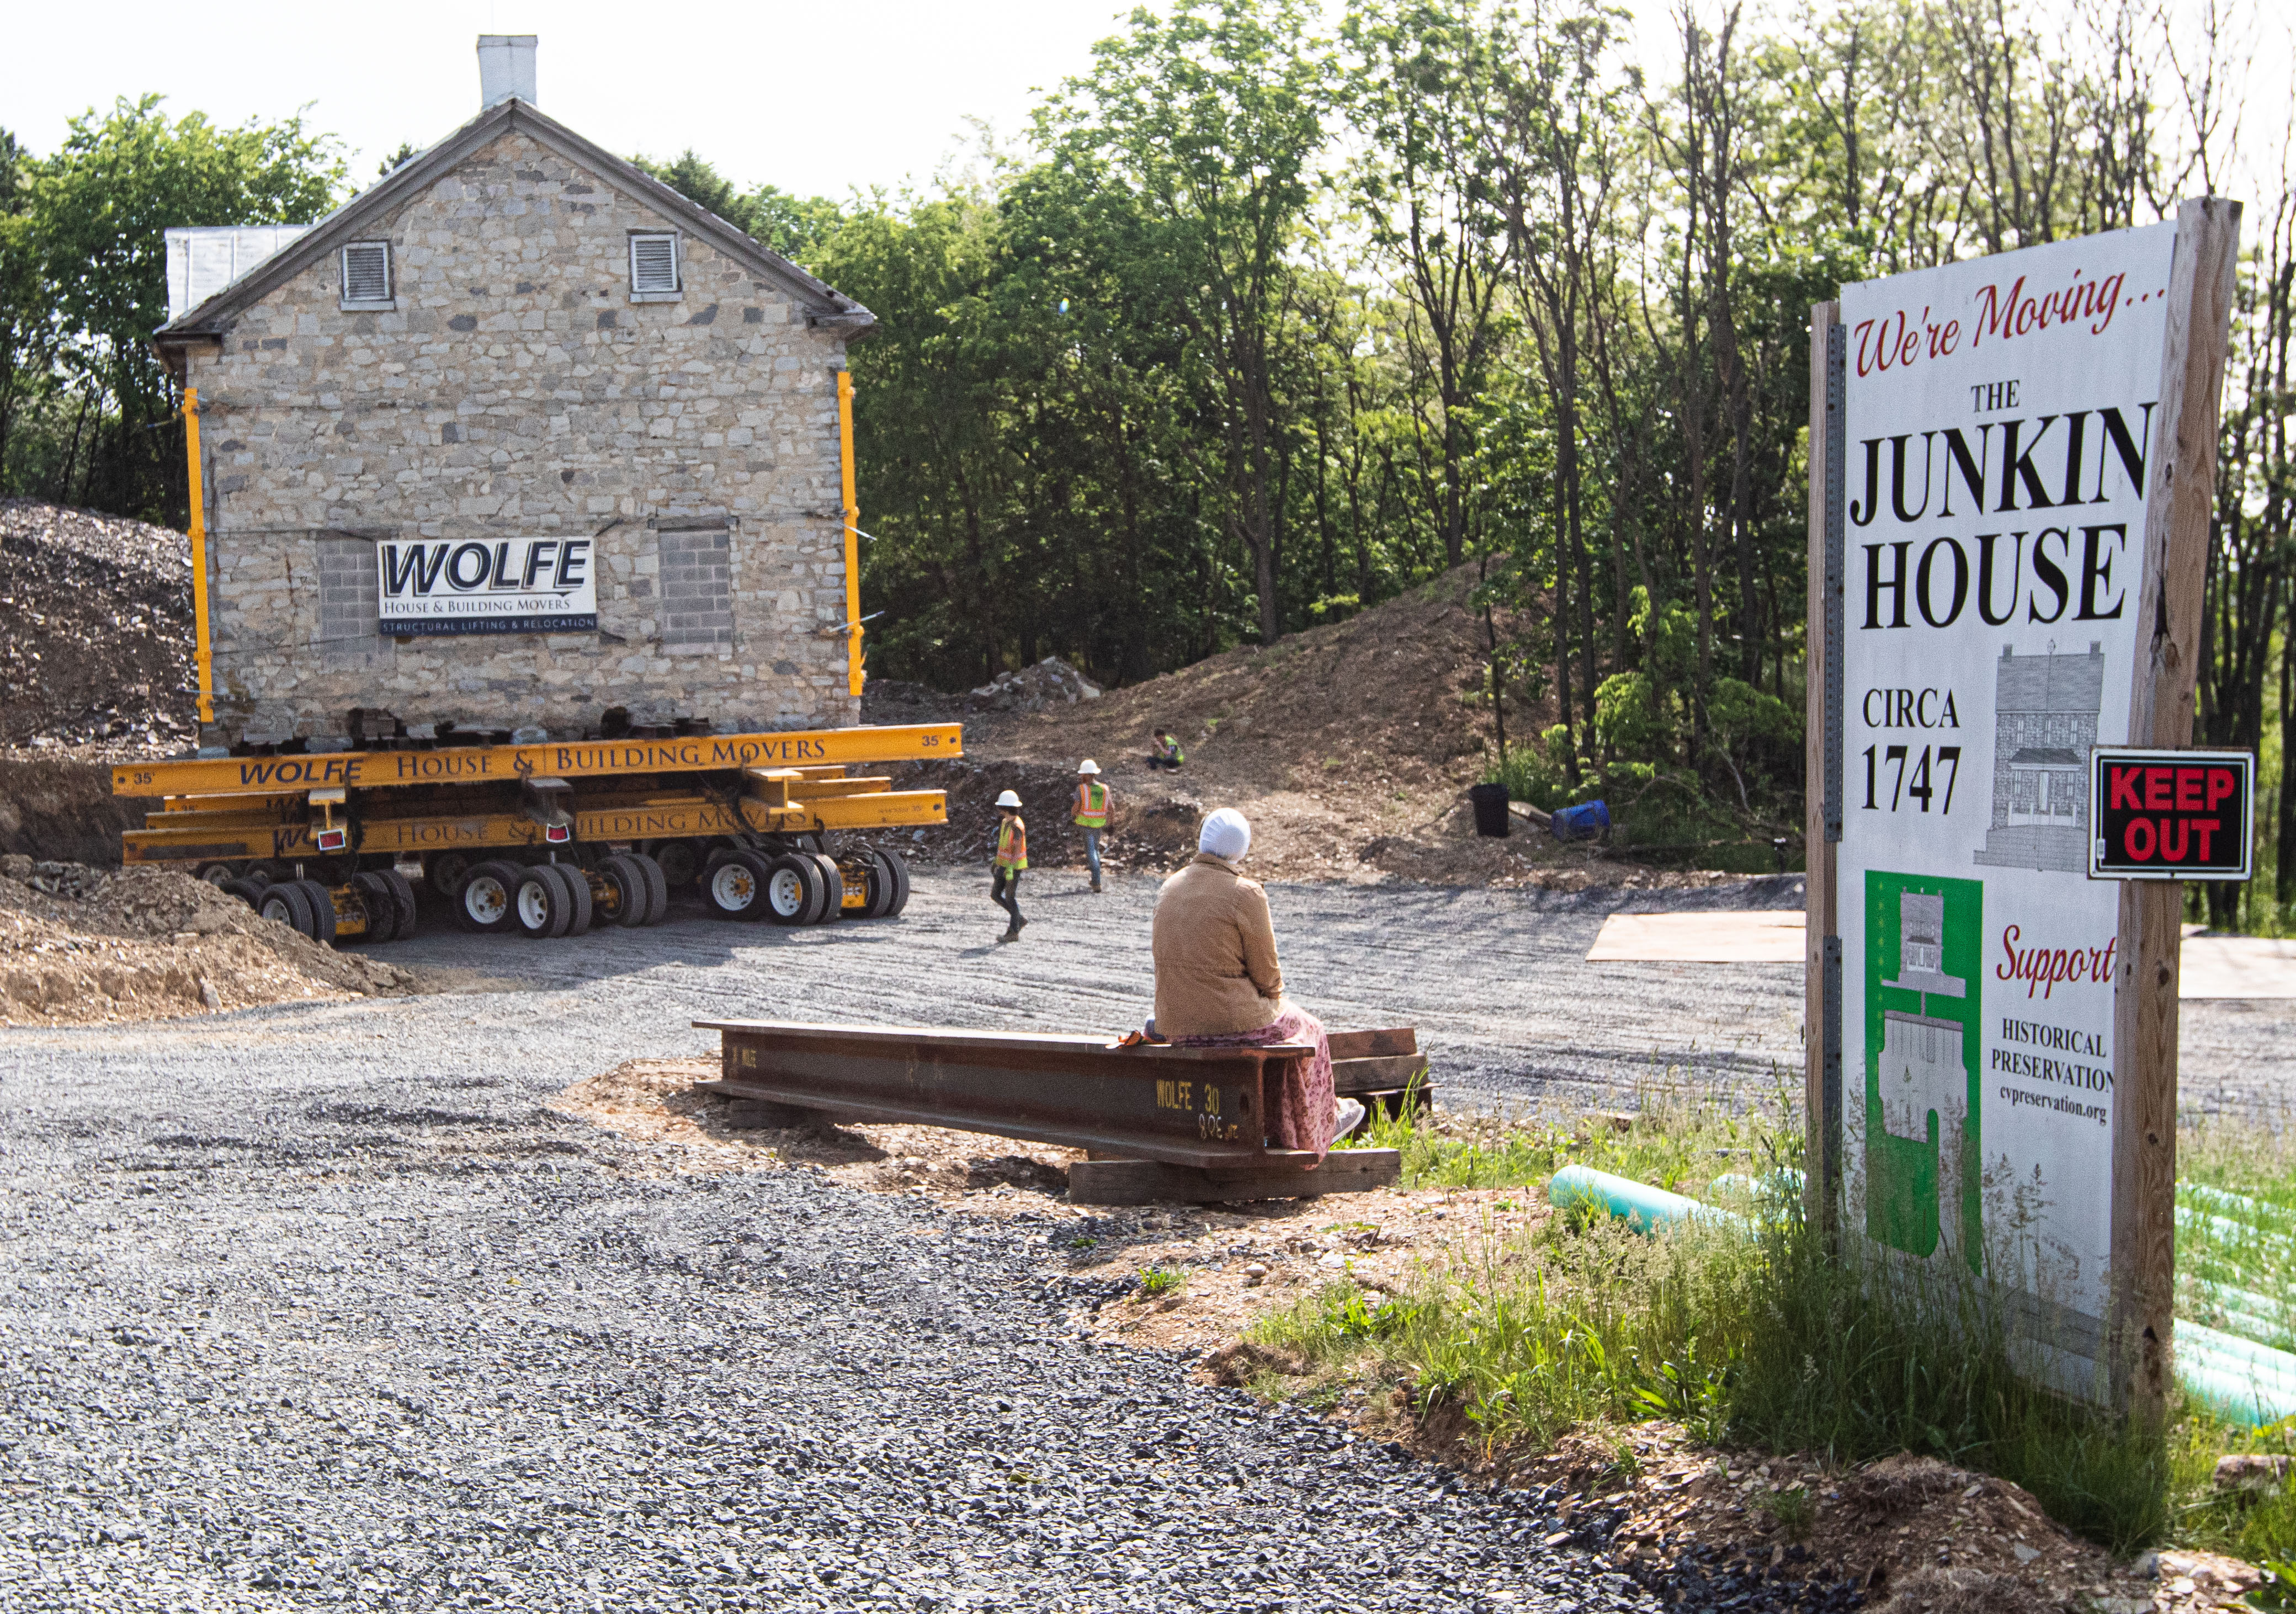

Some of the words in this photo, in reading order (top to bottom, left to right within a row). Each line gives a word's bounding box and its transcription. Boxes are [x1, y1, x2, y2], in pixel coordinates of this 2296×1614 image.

[1853, 306, 1960, 377] We're
[1970, 380, 2021, 412] THE
[1849, 402, 2158, 526] JUNKIN
[381, 541, 590, 597] WOLFE
[1860, 523, 2127, 629] HOUSE
[383, 622, 455, 632] STRUCTURAL
[462, 621, 506, 630] LIFTING
[511, 620, 518, 629] &
[524, 618, 595, 628] RELOCATION
[384, 602, 428, 614] HOUSE
[433, 600, 443, 612] &
[448, 600, 512, 612] BUILDING
[517, 599, 570, 610] MOVERS
[1863, 688, 1960, 728] CIRCA
[240, 758, 363, 785] WOLFE
[397, 755, 492, 777] HOUSE
[513, 750, 533, 773] &
[557, 744, 703, 769] BUILDING
[713, 739, 825, 763] MOVERS
[1862, 744, 1961, 815] 1747
[2111, 767, 2235, 811] KEEP
[2124, 817, 2220, 862] OUT
[1996, 924, 2117, 999] Support
[2002, 1018, 2106, 1058] HISTORICAL
[1991, 1048, 2114, 1093] PRESERVATION
[1157, 1079, 1192, 1110] WOLFE
[1205, 1083, 1220, 1114] 30
